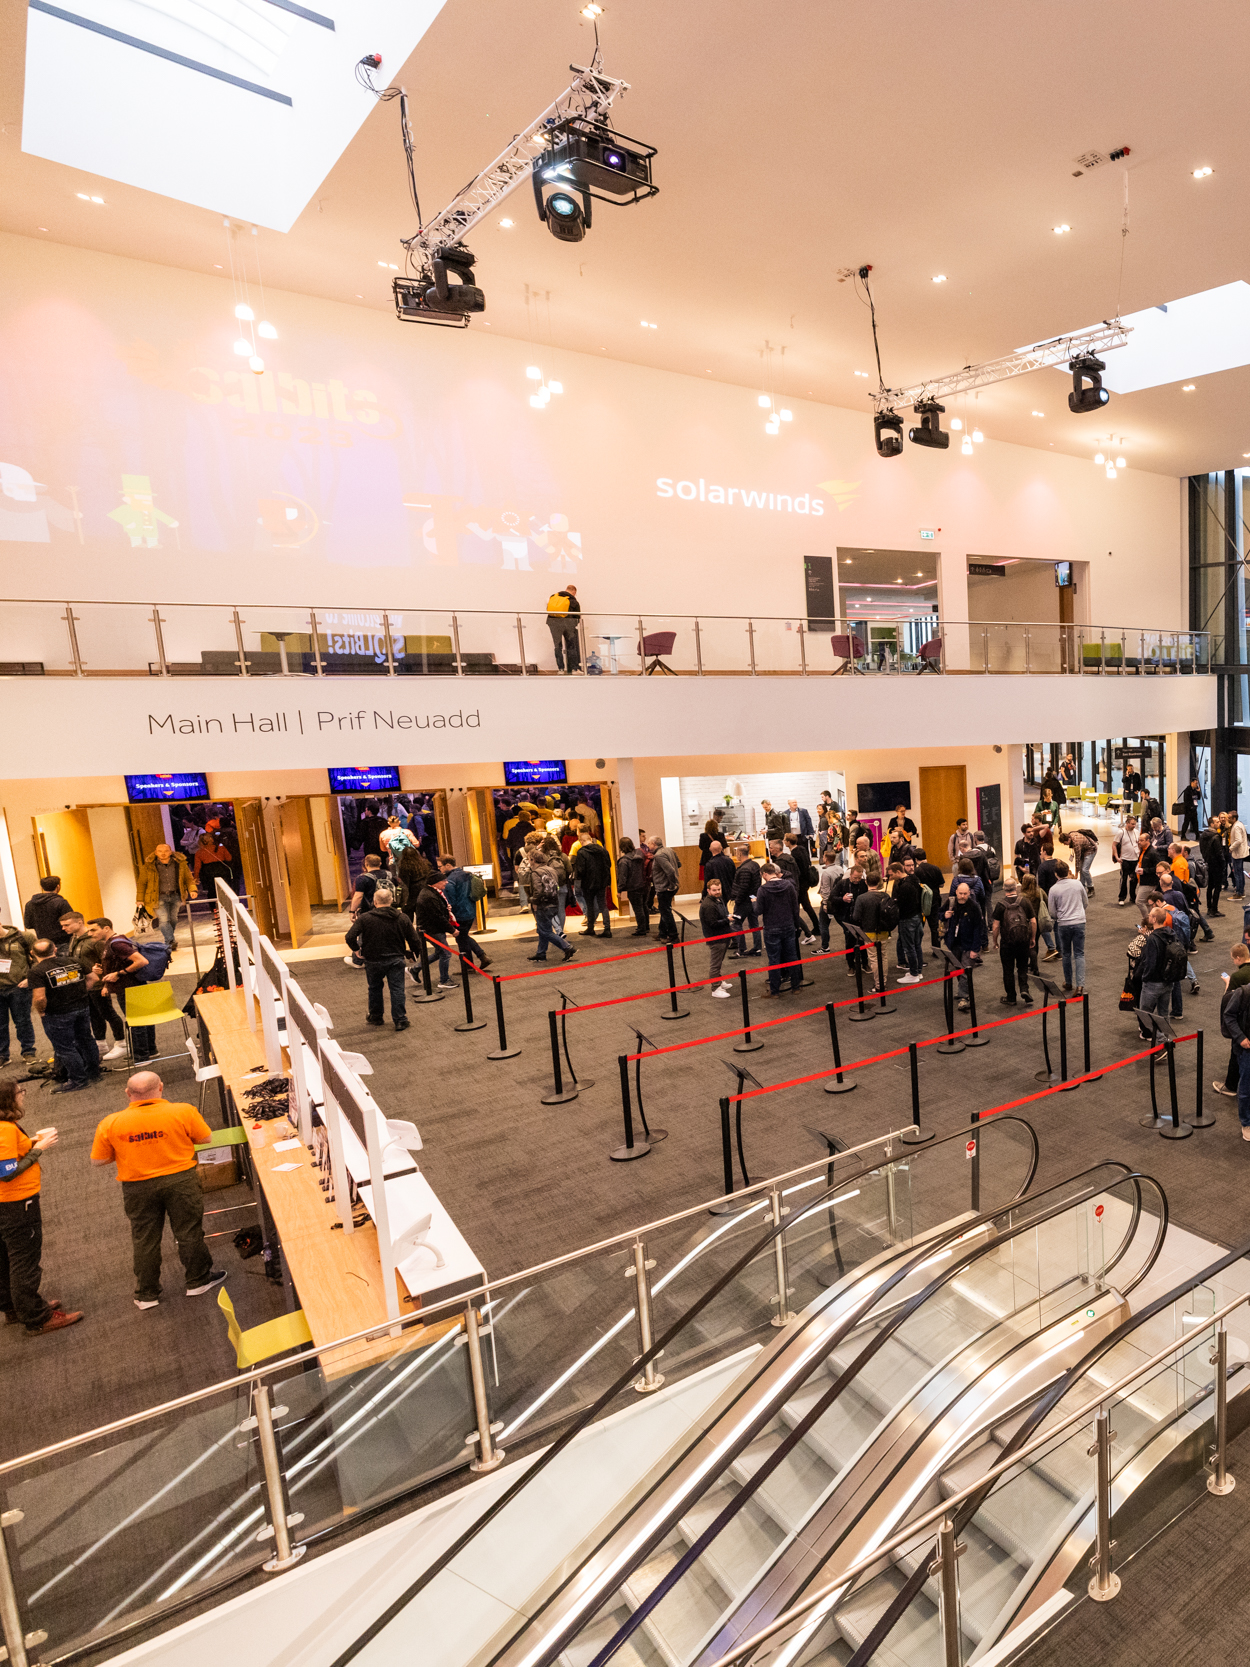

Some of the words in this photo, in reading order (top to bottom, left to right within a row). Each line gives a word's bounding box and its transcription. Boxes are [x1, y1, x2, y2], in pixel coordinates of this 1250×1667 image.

[656, 477, 824, 516] solarwinds
[148, 713, 223, 735] Main
[232, 712, 287, 732] Hall
[316, 710, 366, 731] Prif
[373, 709, 481, 730] Neuadd
[135, 782, 164, 790] Speakers
